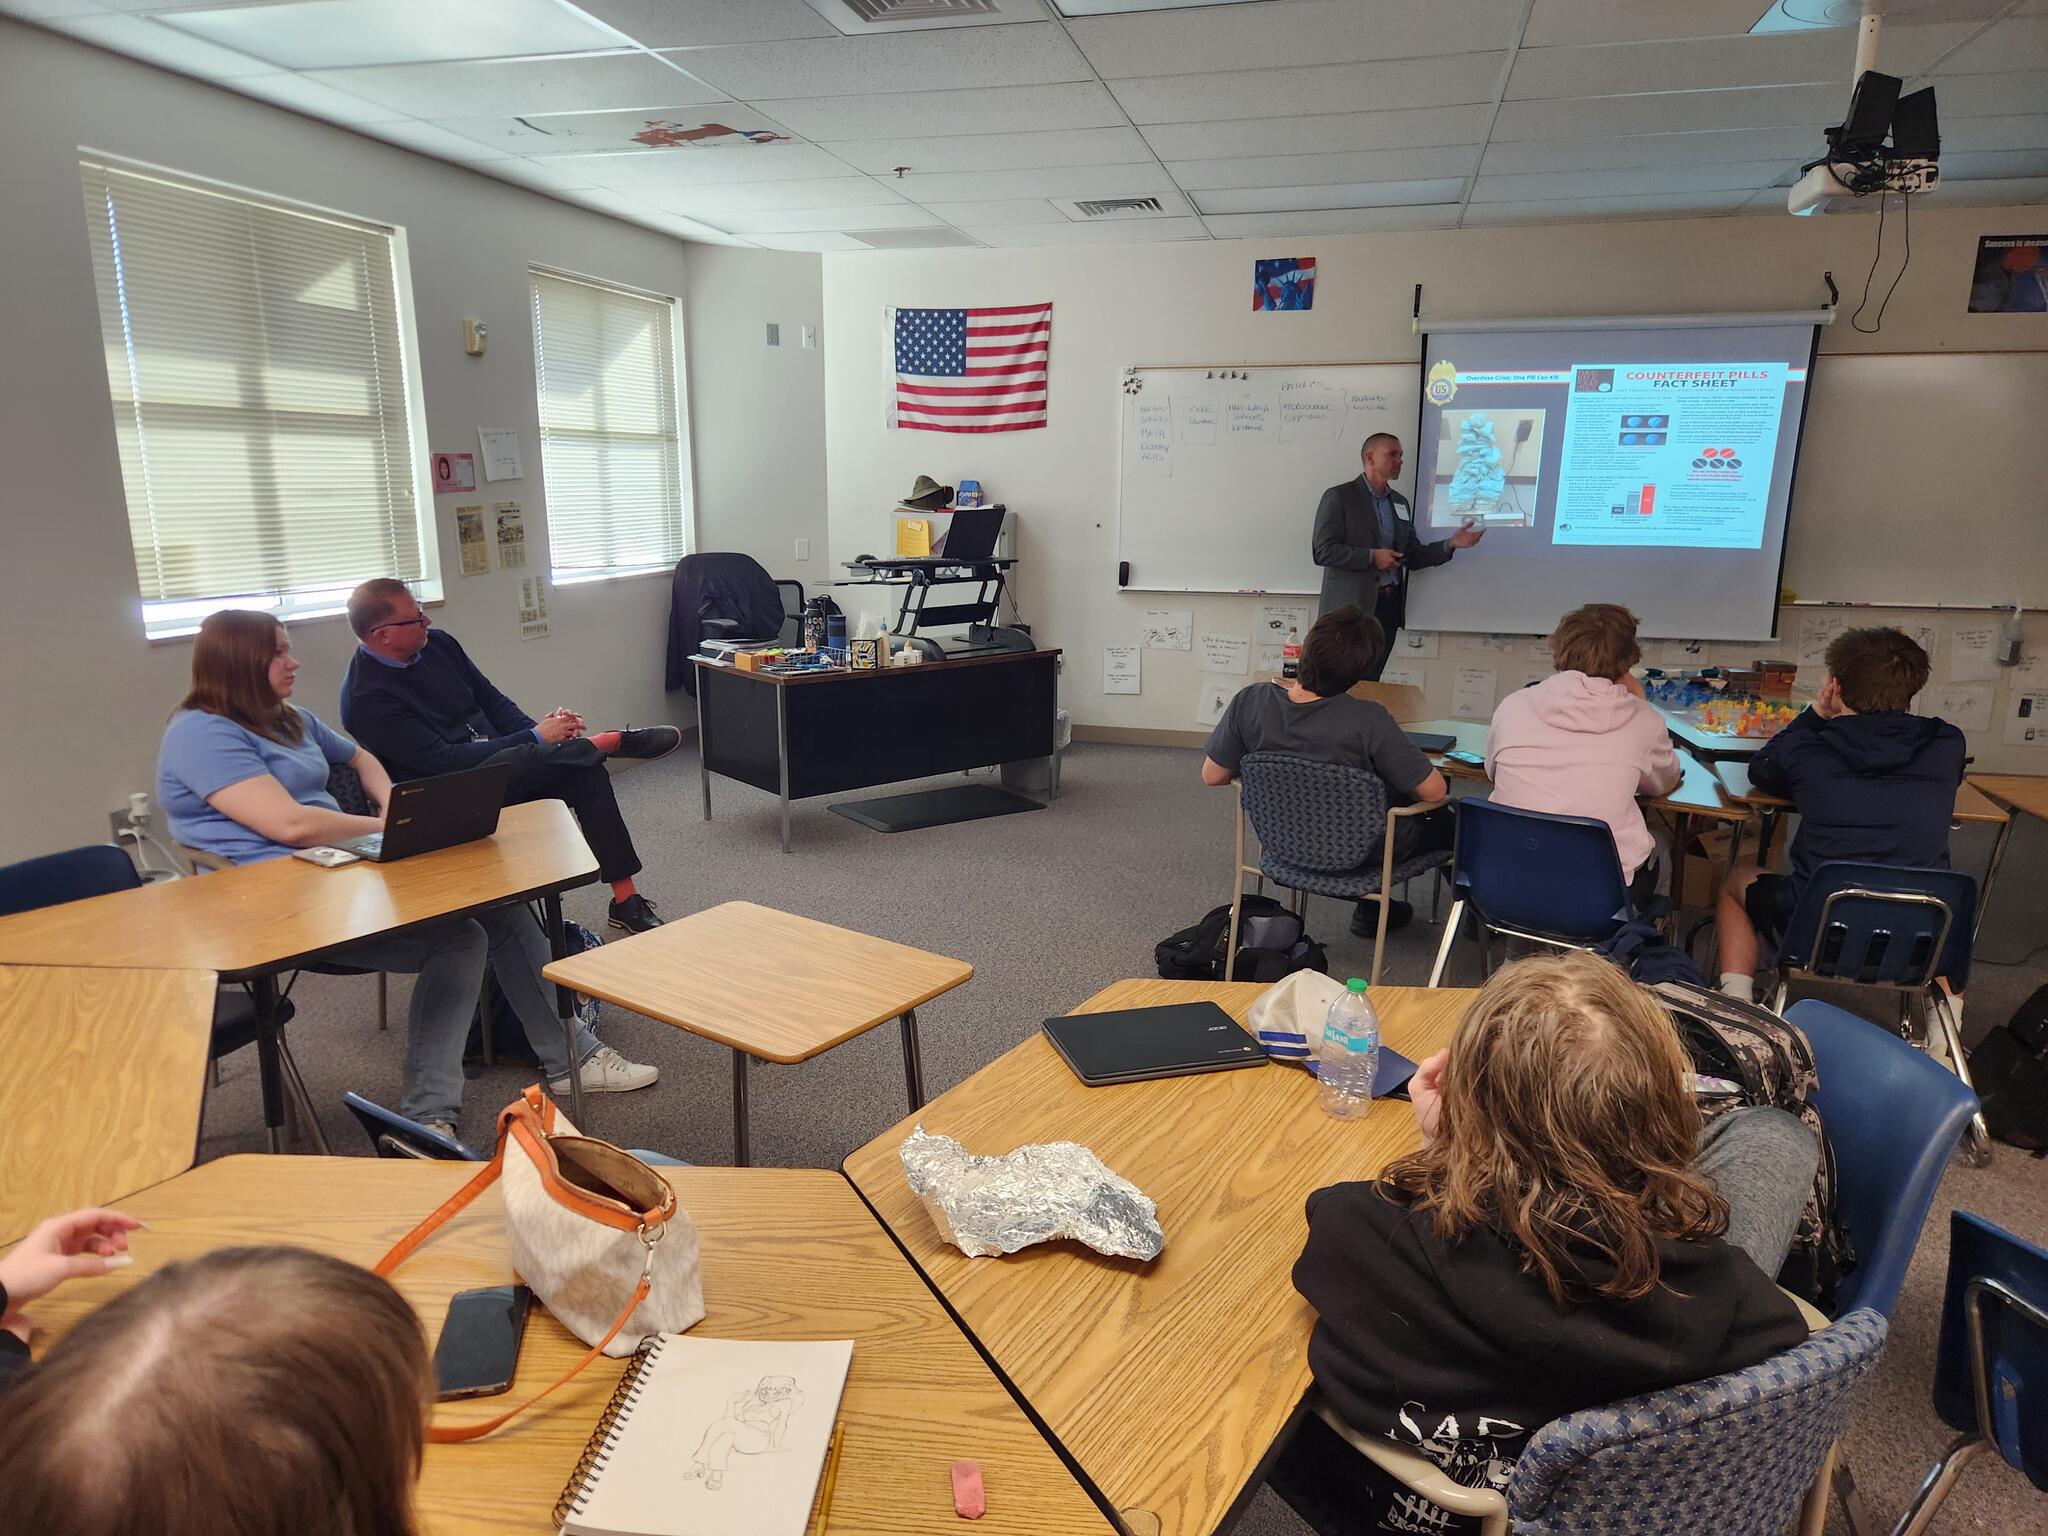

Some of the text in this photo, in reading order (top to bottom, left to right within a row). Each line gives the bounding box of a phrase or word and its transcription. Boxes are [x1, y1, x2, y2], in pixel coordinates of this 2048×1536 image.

[1626, 370, 1769, 380] COUNTERFEIT PILLS
[1654, 379, 1738, 388] FACT SHEET
